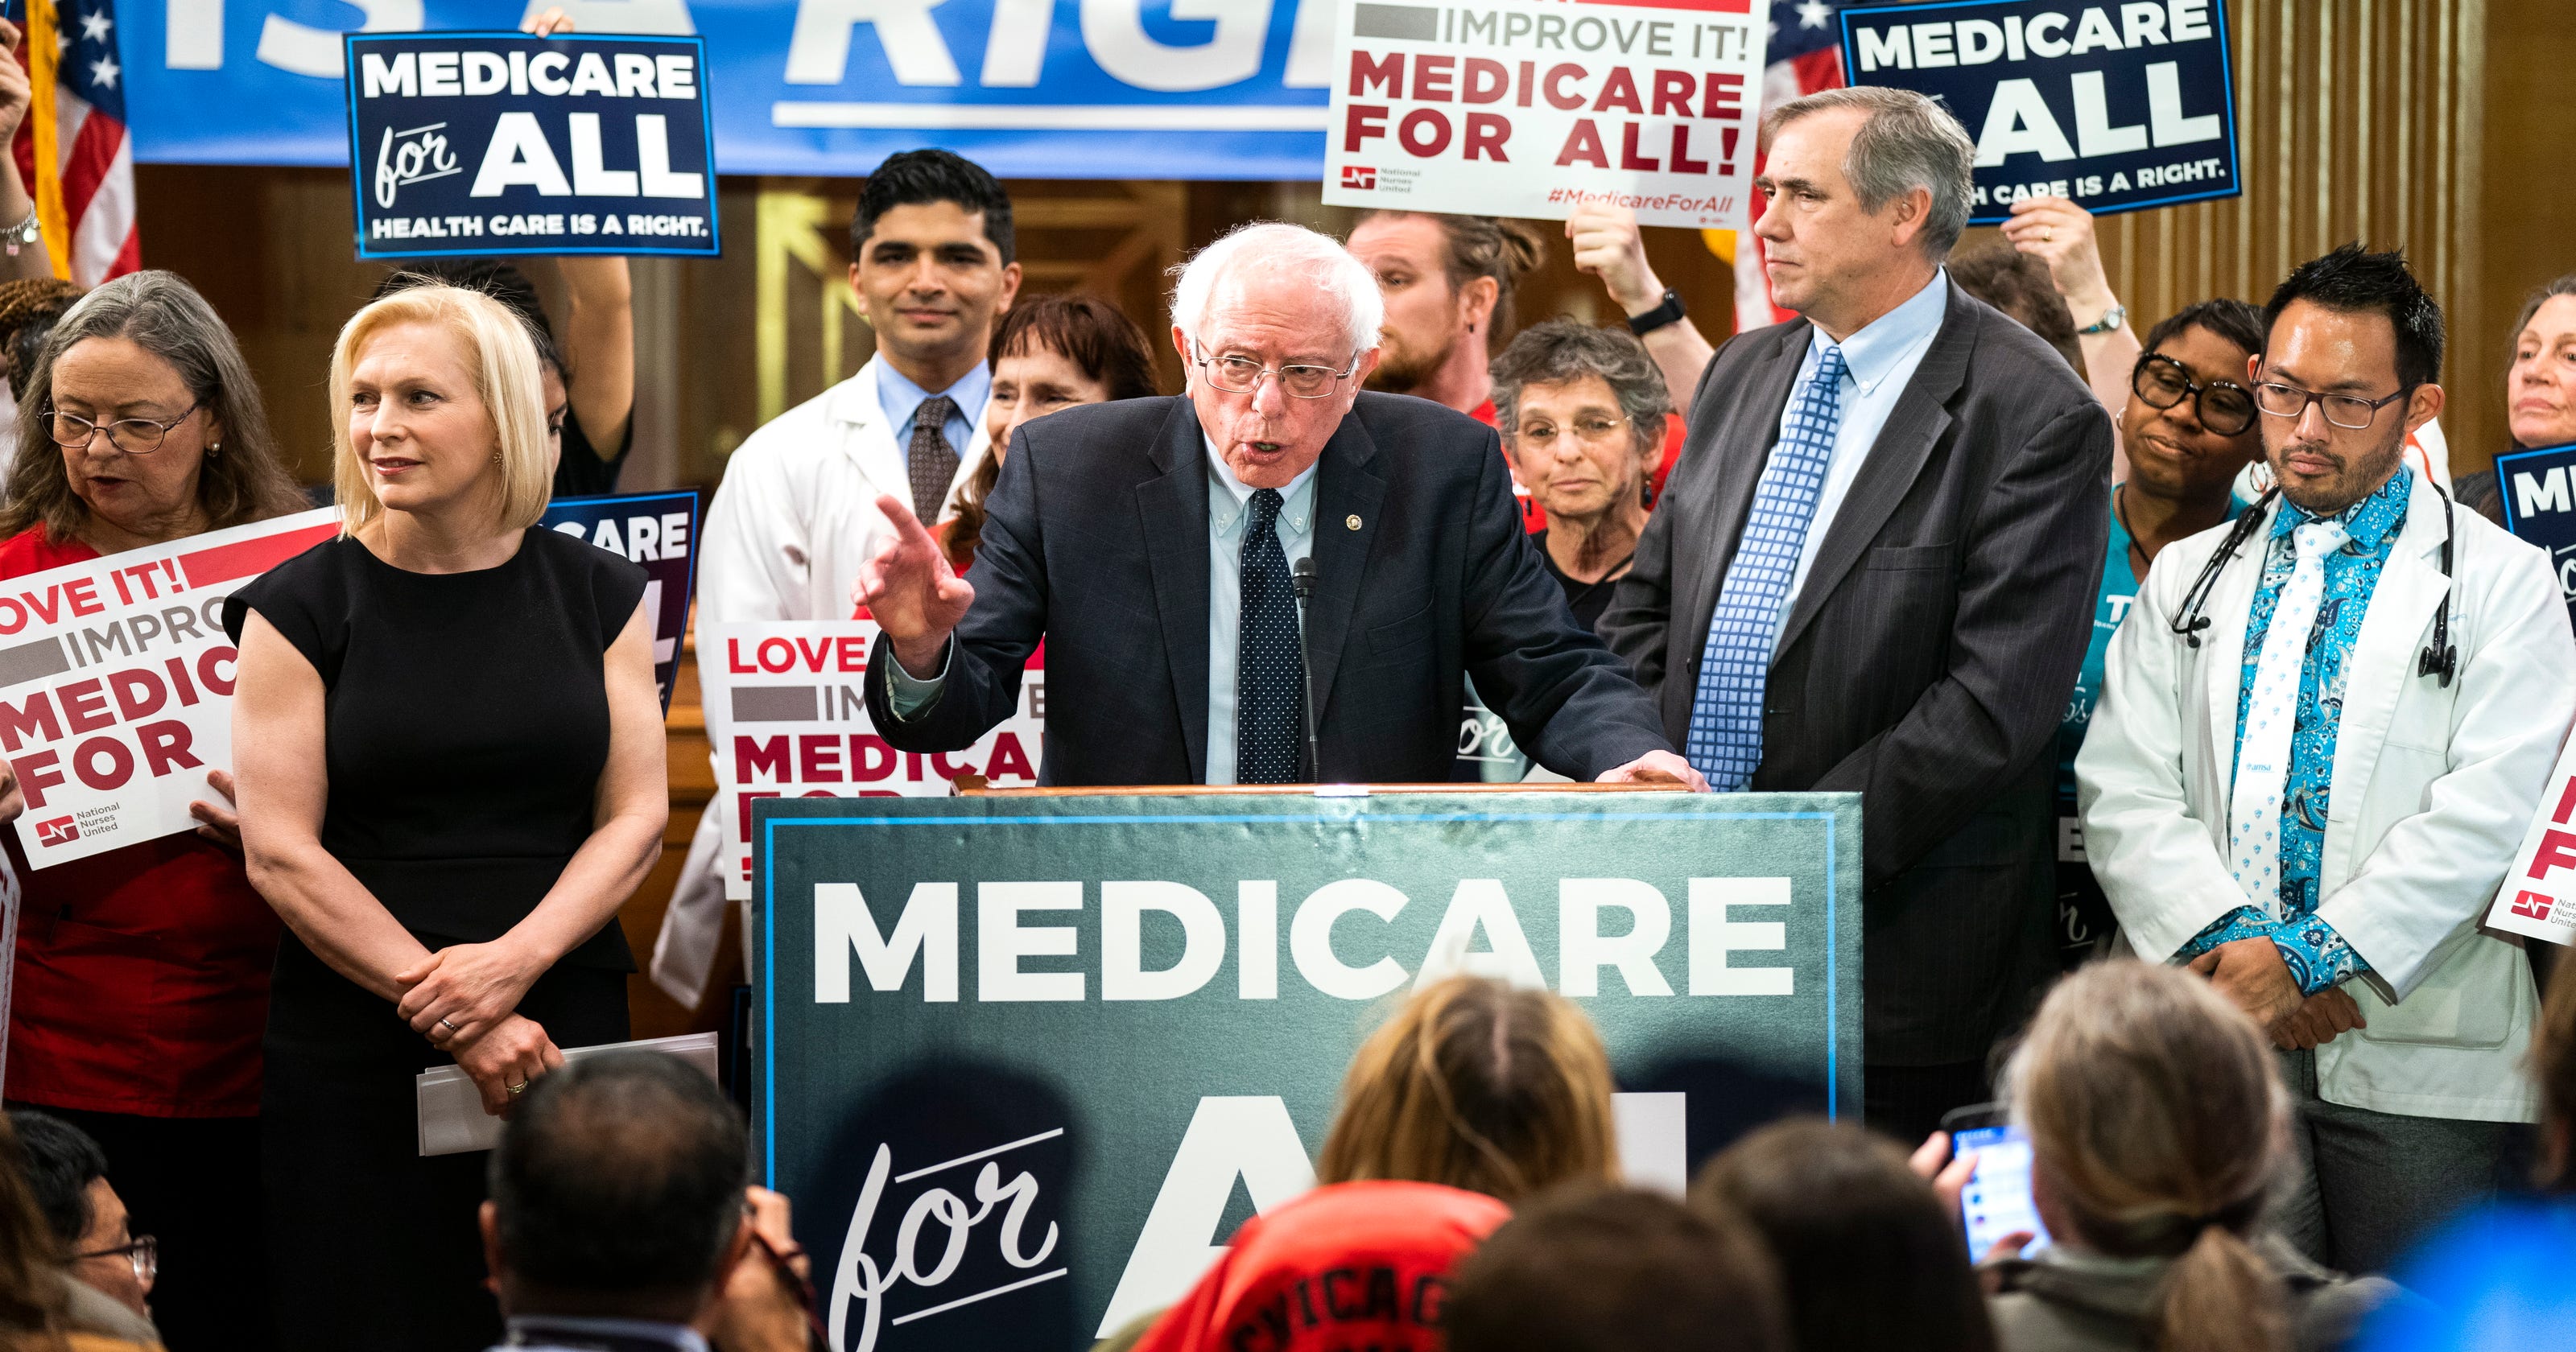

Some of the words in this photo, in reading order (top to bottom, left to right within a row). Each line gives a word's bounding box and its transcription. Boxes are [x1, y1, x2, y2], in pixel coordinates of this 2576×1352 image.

[1443, 9, 1674, 56] IMPROVE
[1692, 24, 1748, 61] IT!
[1856, 0, 2212, 72] MEDICARE
[361, 51, 697, 99] MEDICARE
[1348, 50, 1745, 120] MEDICARE
[1971, 60, 2222, 167] ALL
[375, 126, 456, 208] for
[469, 112, 705, 199] ALL
[1344, 105, 1512, 163] FOR
[1554, 118, 1740, 176] ALL!
[1548, 188, 1734, 213] #MedicareForAll
[1992, 179, 2070, 204] CARE
[2076, 175, 2103, 197] IS
[2109, 171, 2132, 193] A
[2136, 158, 2226, 188] RIGHT.
[372, 216, 483, 240] HEALTH
[489, 215, 564, 236] CARE
[571, 214, 597, 234] IS
[602, 215, 624, 235] A
[628, 215, 708, 237] RIGHT.
[110, 559, 184, 606] IT!
[67, 596, 228, 668] IMPRO
[728, 637, 867, 674] LOVE
[0, 646, 239, 753] MEDIC
[10, 719, 205, 810] FOR
[734, 732, 1044, 785] MEDICA
[76, 802, 121, 820] National
[80, 814, 116, 829] Nurses
[83, 822, 118, 838] United
[814, 876, 1794, 1004] MEDICARE
[828, 1143, 1059, 1352] for
